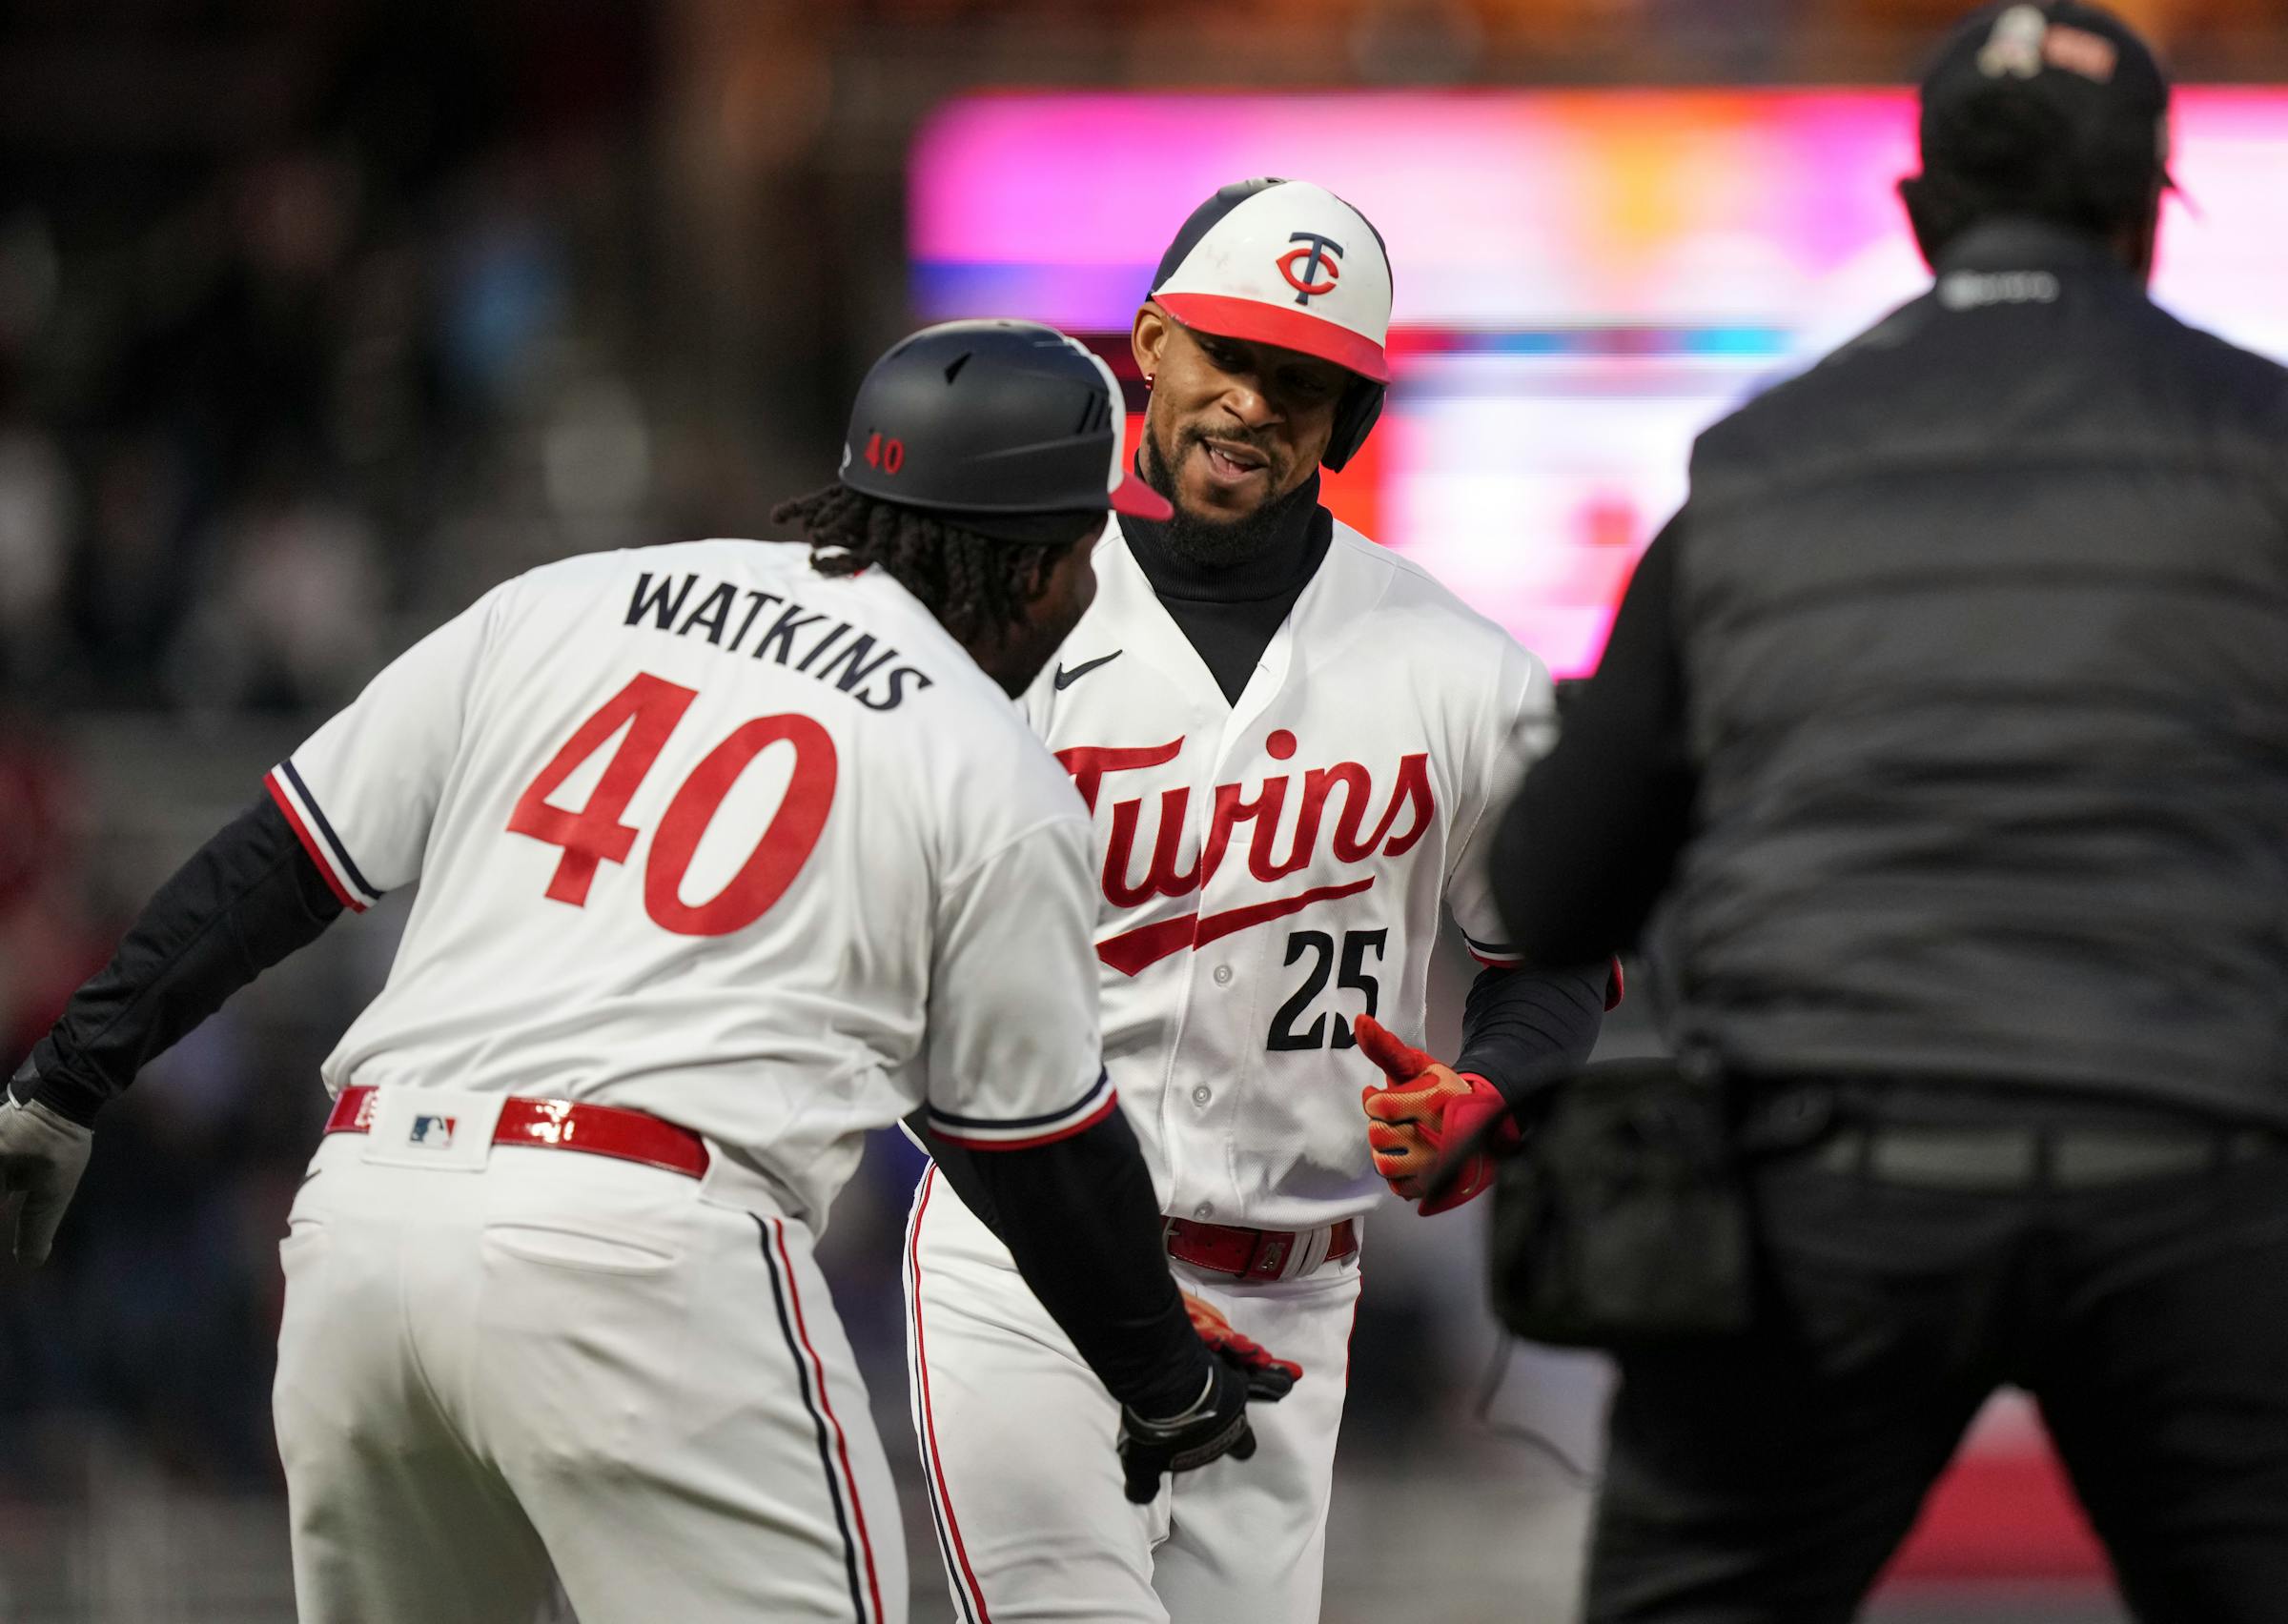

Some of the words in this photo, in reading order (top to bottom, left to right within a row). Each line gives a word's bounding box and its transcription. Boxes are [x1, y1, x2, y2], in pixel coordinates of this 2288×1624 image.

[864, 432, 905, 475] 40
[623, 572, 934, 713] WATKINS
[505, 671, 838, 937] 40
[1052, 728, 1435, 908] Twins
[1266, 927, 1389, 1051] 25
